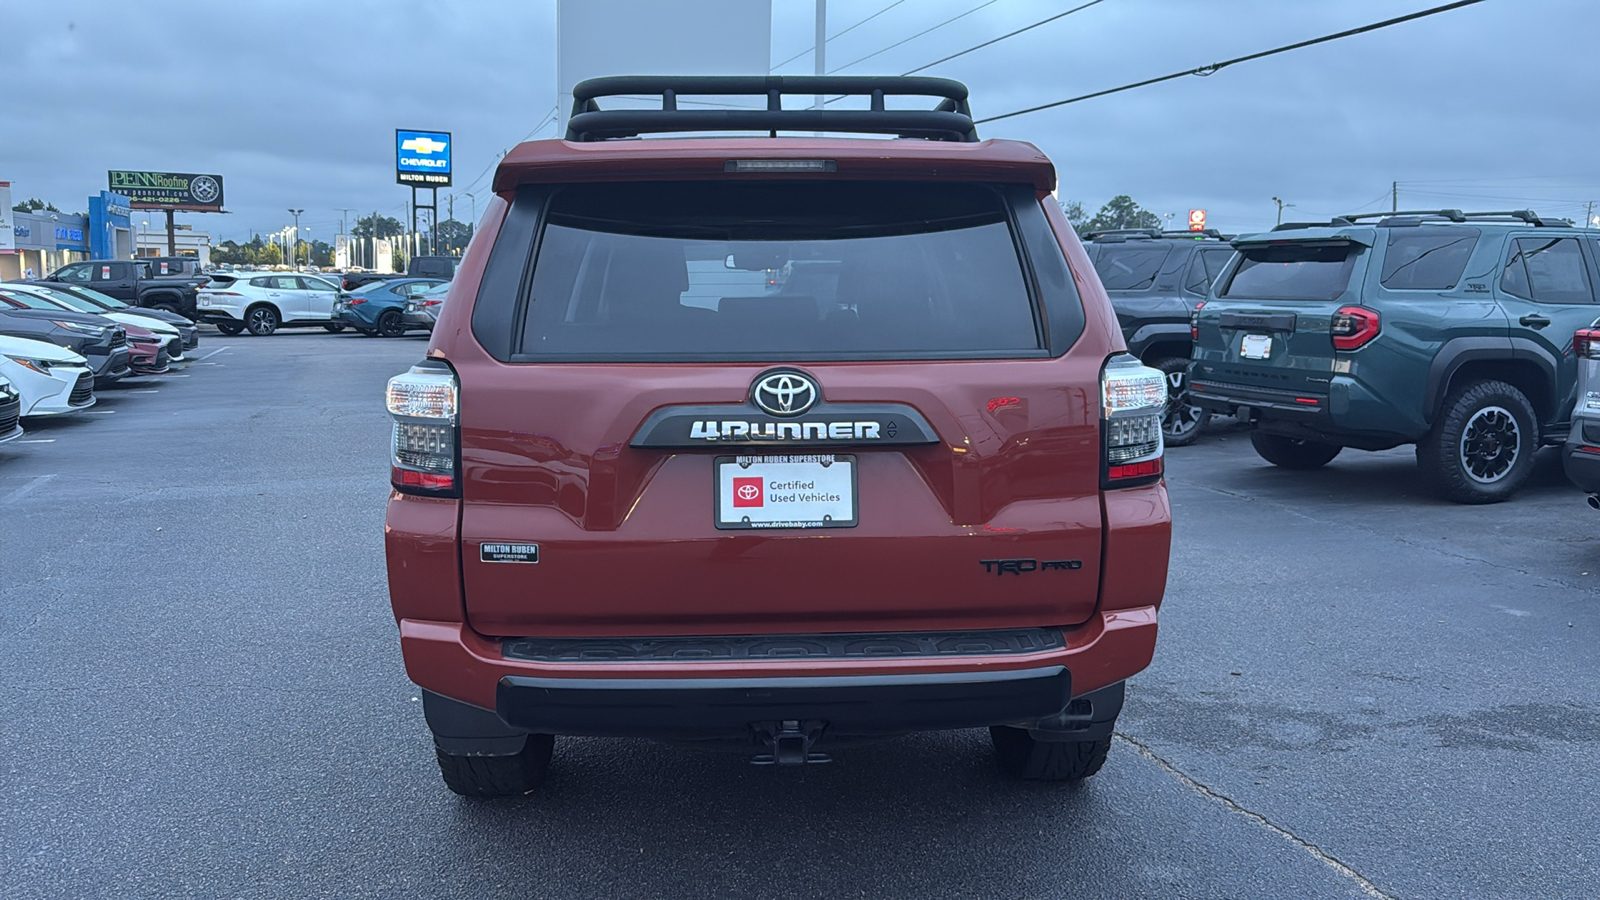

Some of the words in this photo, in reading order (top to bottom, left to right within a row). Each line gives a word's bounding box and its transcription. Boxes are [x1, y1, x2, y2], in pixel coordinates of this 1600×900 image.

[400, 157, 447, 168] CHEVROLET
[110, 171, 158, 186] PENN
[157, 176, 188, 189] Roofing
[400, 173, 424, 181] MILTON
[425, 175, 448, 183] RUBEN
[111, 189, 189, 198] www.pennroof.com
[736, 455, 763, 463] MILTON
[764, 455, 788, 463] RUBEN
[789, 454, 836, 463] SUPERSTORE
[769, 481, 814, 490] Certified
[769, 494, 796, 503] Used
[798, 493, 841, 502] Vehicles
[751, 520, 823, 528] www.drivebaby.com
[483, 544, 510, 553] MILTON
[511, 545, 536, 554] RUBEN
[979, 558, 1037, 576] TRD
[1041, 560, 1082, 571] PRO
